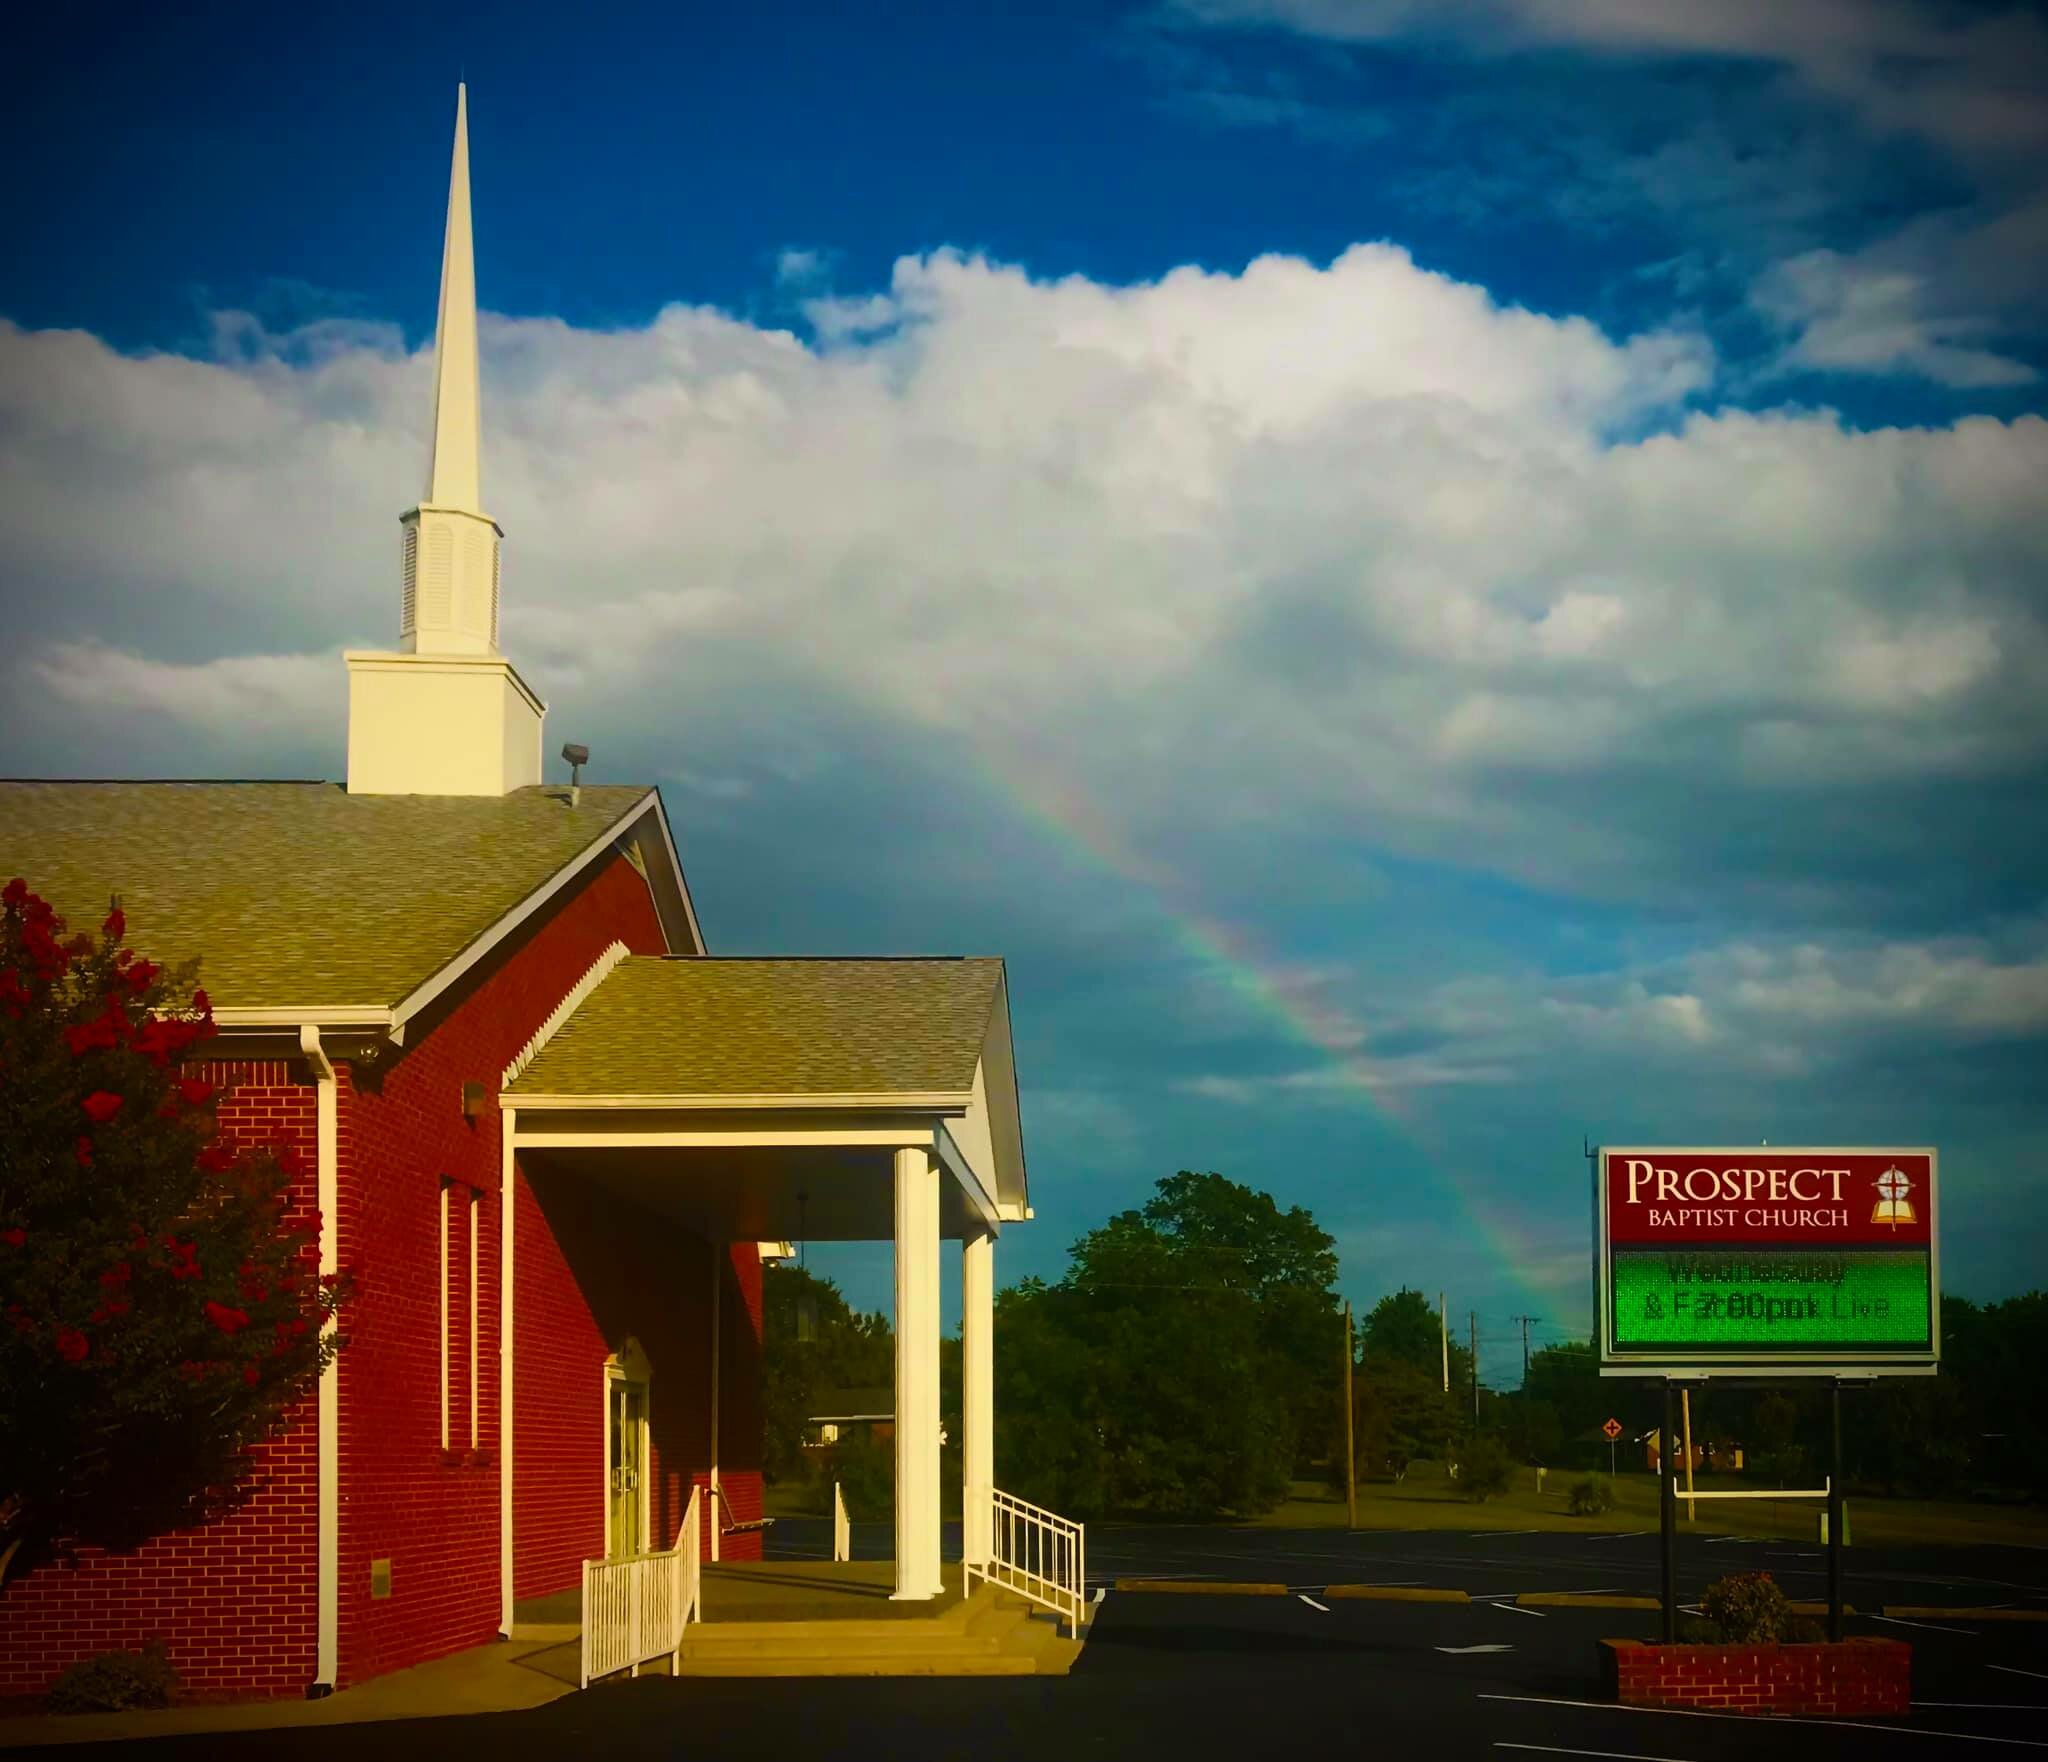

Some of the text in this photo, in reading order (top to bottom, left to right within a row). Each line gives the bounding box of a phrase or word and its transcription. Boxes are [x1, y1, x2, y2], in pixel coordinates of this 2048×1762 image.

[1624, 1160, 1851, 1204] PROSPECT
[1649, 1209, 1849, 1227] BAPTIST CHURCH
